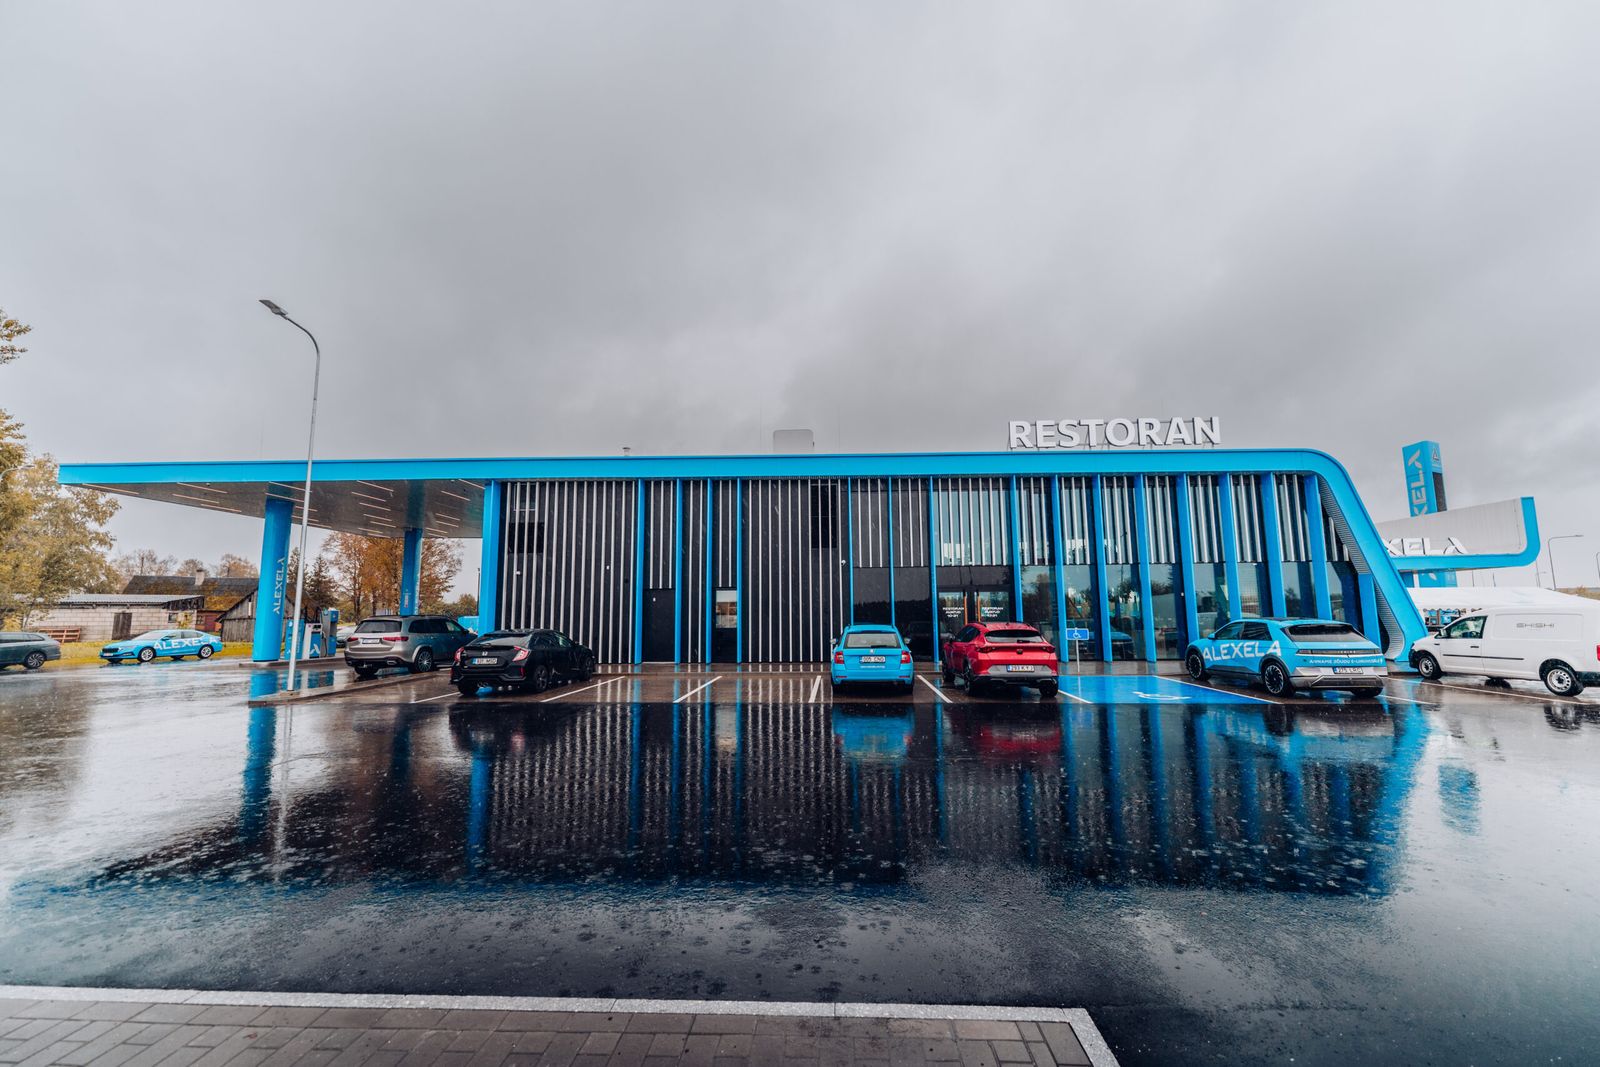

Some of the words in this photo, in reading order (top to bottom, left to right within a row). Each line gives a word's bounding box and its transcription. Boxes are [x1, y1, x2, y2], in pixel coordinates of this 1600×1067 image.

[1009, 416, 1221, 448] RESTORAN
[272, 557, 286, 615] ALEXELA
[153, 637, 218, 651] ALEXELA
[1203, 640, 1282, 661] ALEXELA
